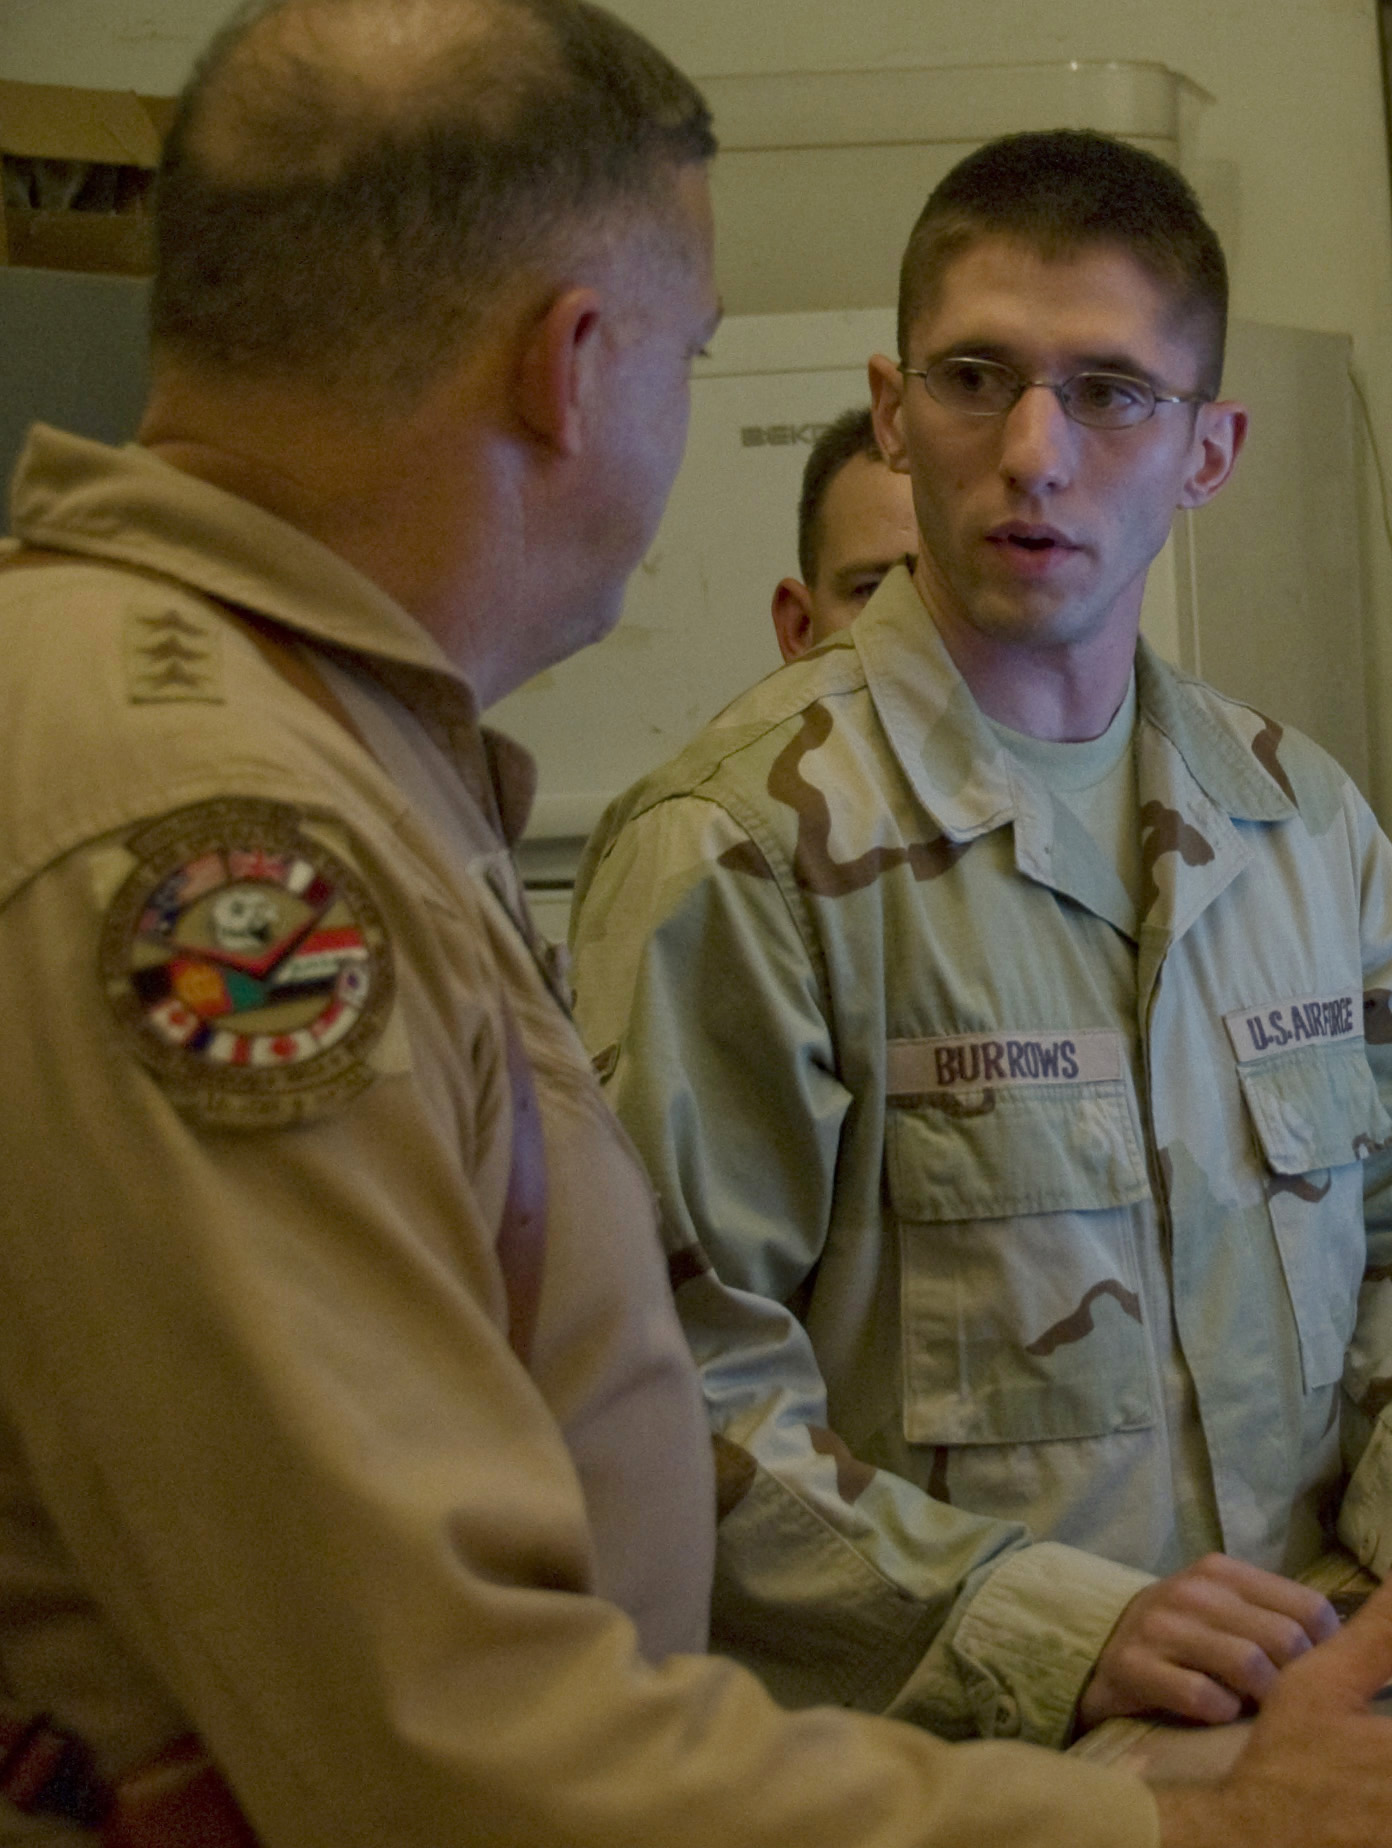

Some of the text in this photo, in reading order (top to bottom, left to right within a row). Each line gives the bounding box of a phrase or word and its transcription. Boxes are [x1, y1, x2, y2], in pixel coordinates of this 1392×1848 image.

[1247, 997, 1353, 1051] U.S. AIR FORCE
[934, 1039, 1079, 1086] BURROWS
